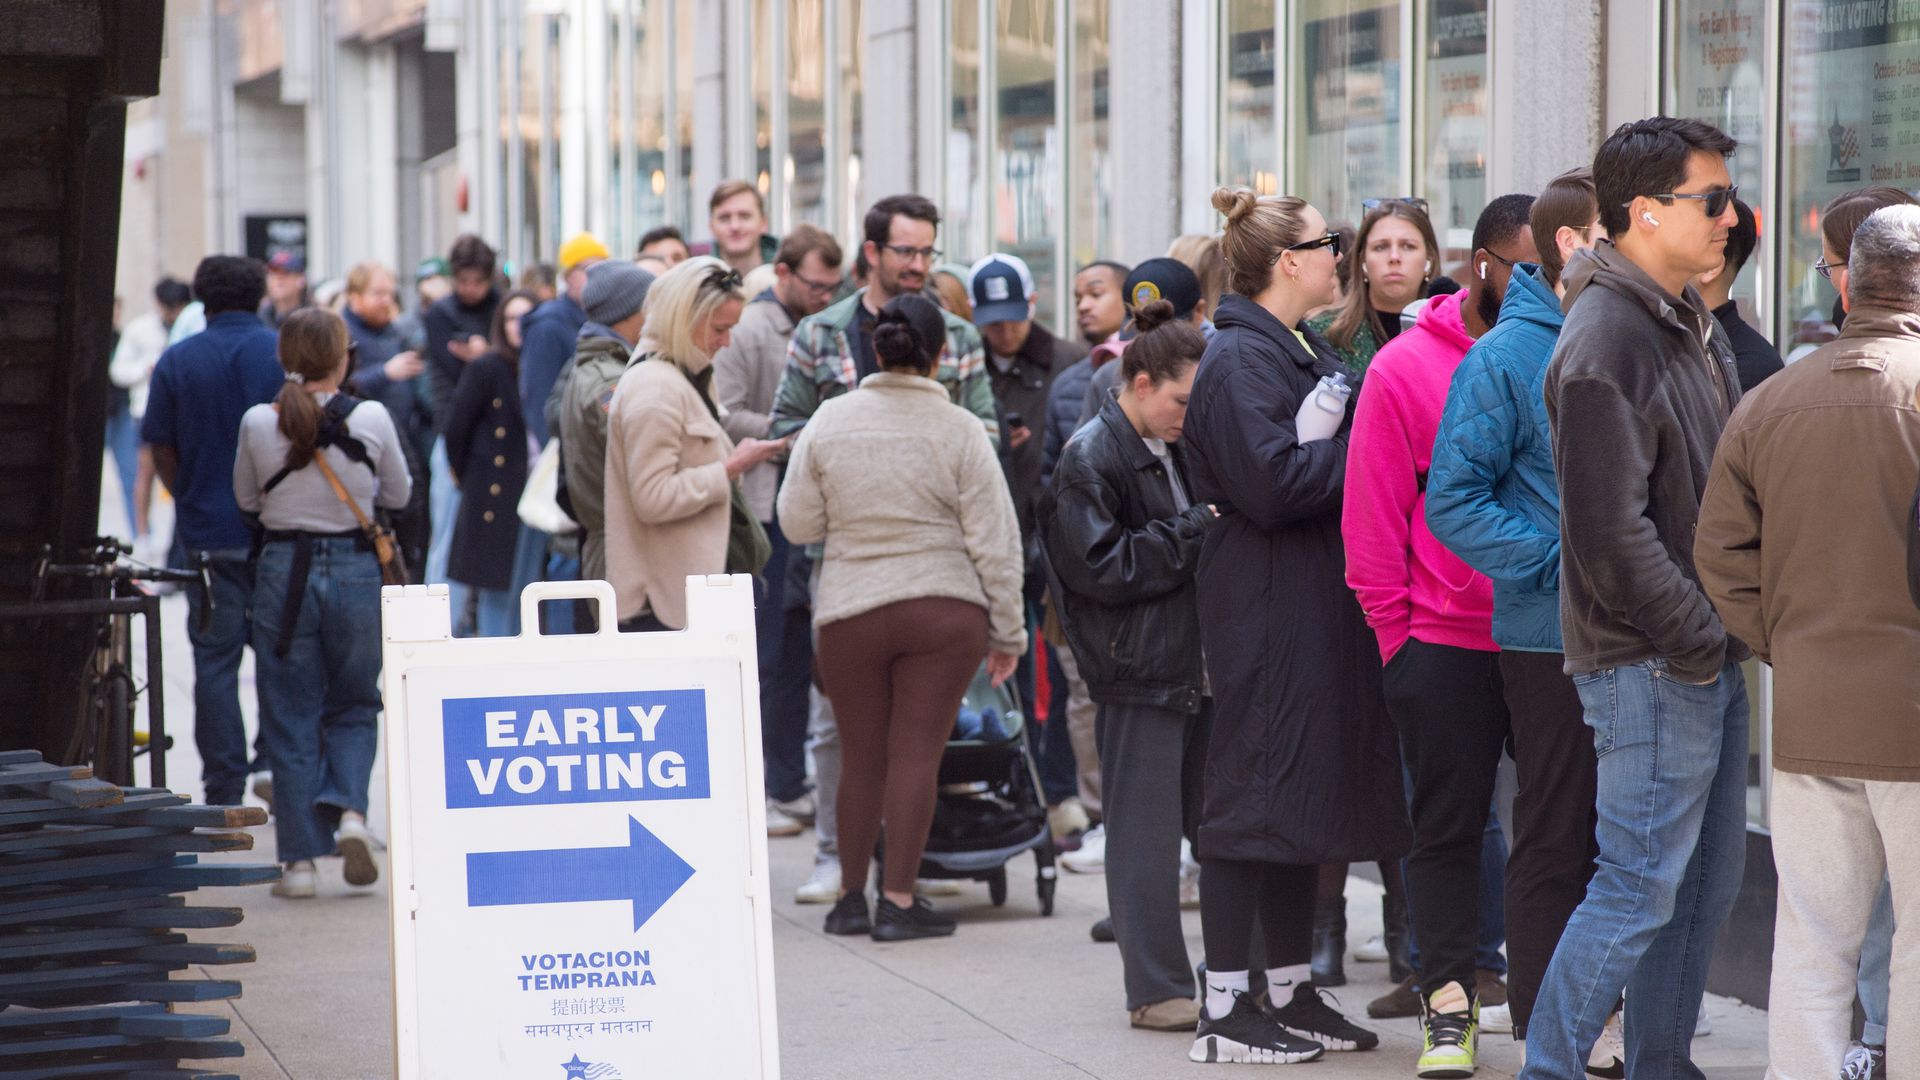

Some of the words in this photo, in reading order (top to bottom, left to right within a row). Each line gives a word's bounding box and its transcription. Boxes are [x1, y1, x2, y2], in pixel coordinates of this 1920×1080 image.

[1847, 0, 1885, 29] VOTING
[1886, 0, 1895, 24] &
[485, 704, 667, 748] EARLY
[466, 751, 687, 795] VOTING
[521, 950, 650, 971] VOTACION
[517, 970, 657, 991] TEMPRANA
[551, 996, 625, 1016] 提前投票
[600, 1020, 653, 1036] मतदान
